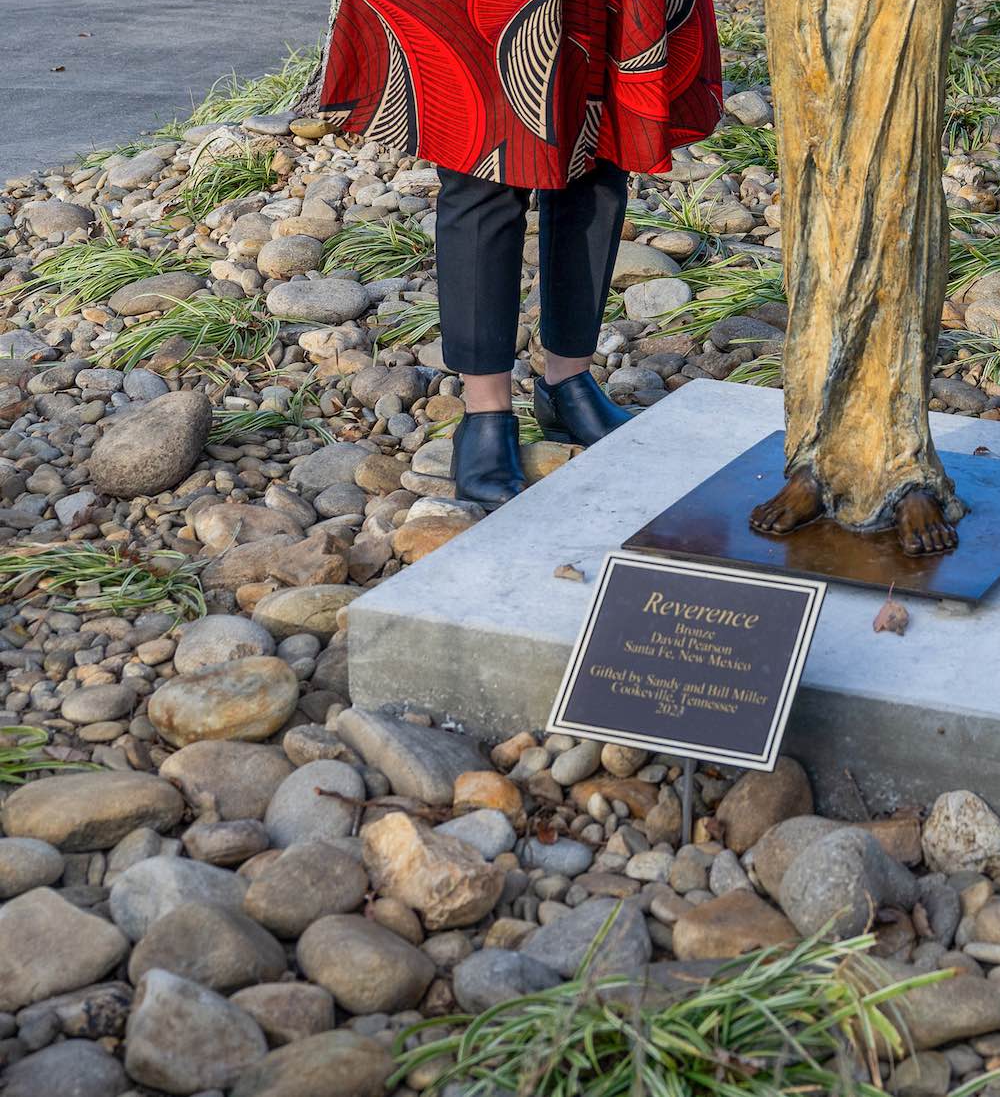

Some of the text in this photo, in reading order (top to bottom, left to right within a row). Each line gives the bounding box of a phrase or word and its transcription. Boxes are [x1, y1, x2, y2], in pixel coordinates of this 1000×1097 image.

[643, 591, 760, 629] Reverence
[651, 631, 733, 655] David Pearson
[675, 623, 716, 640] Bronze
[624, 640, 656, 655] Santa
[679, 649, 706, 663] New
[708, 654, 752, 671] Mexico
[590, 665, 769, 705] Gifted by Sandy and Bill Miller
[611, 681, 739, 714] Cookeville, Tennessee
